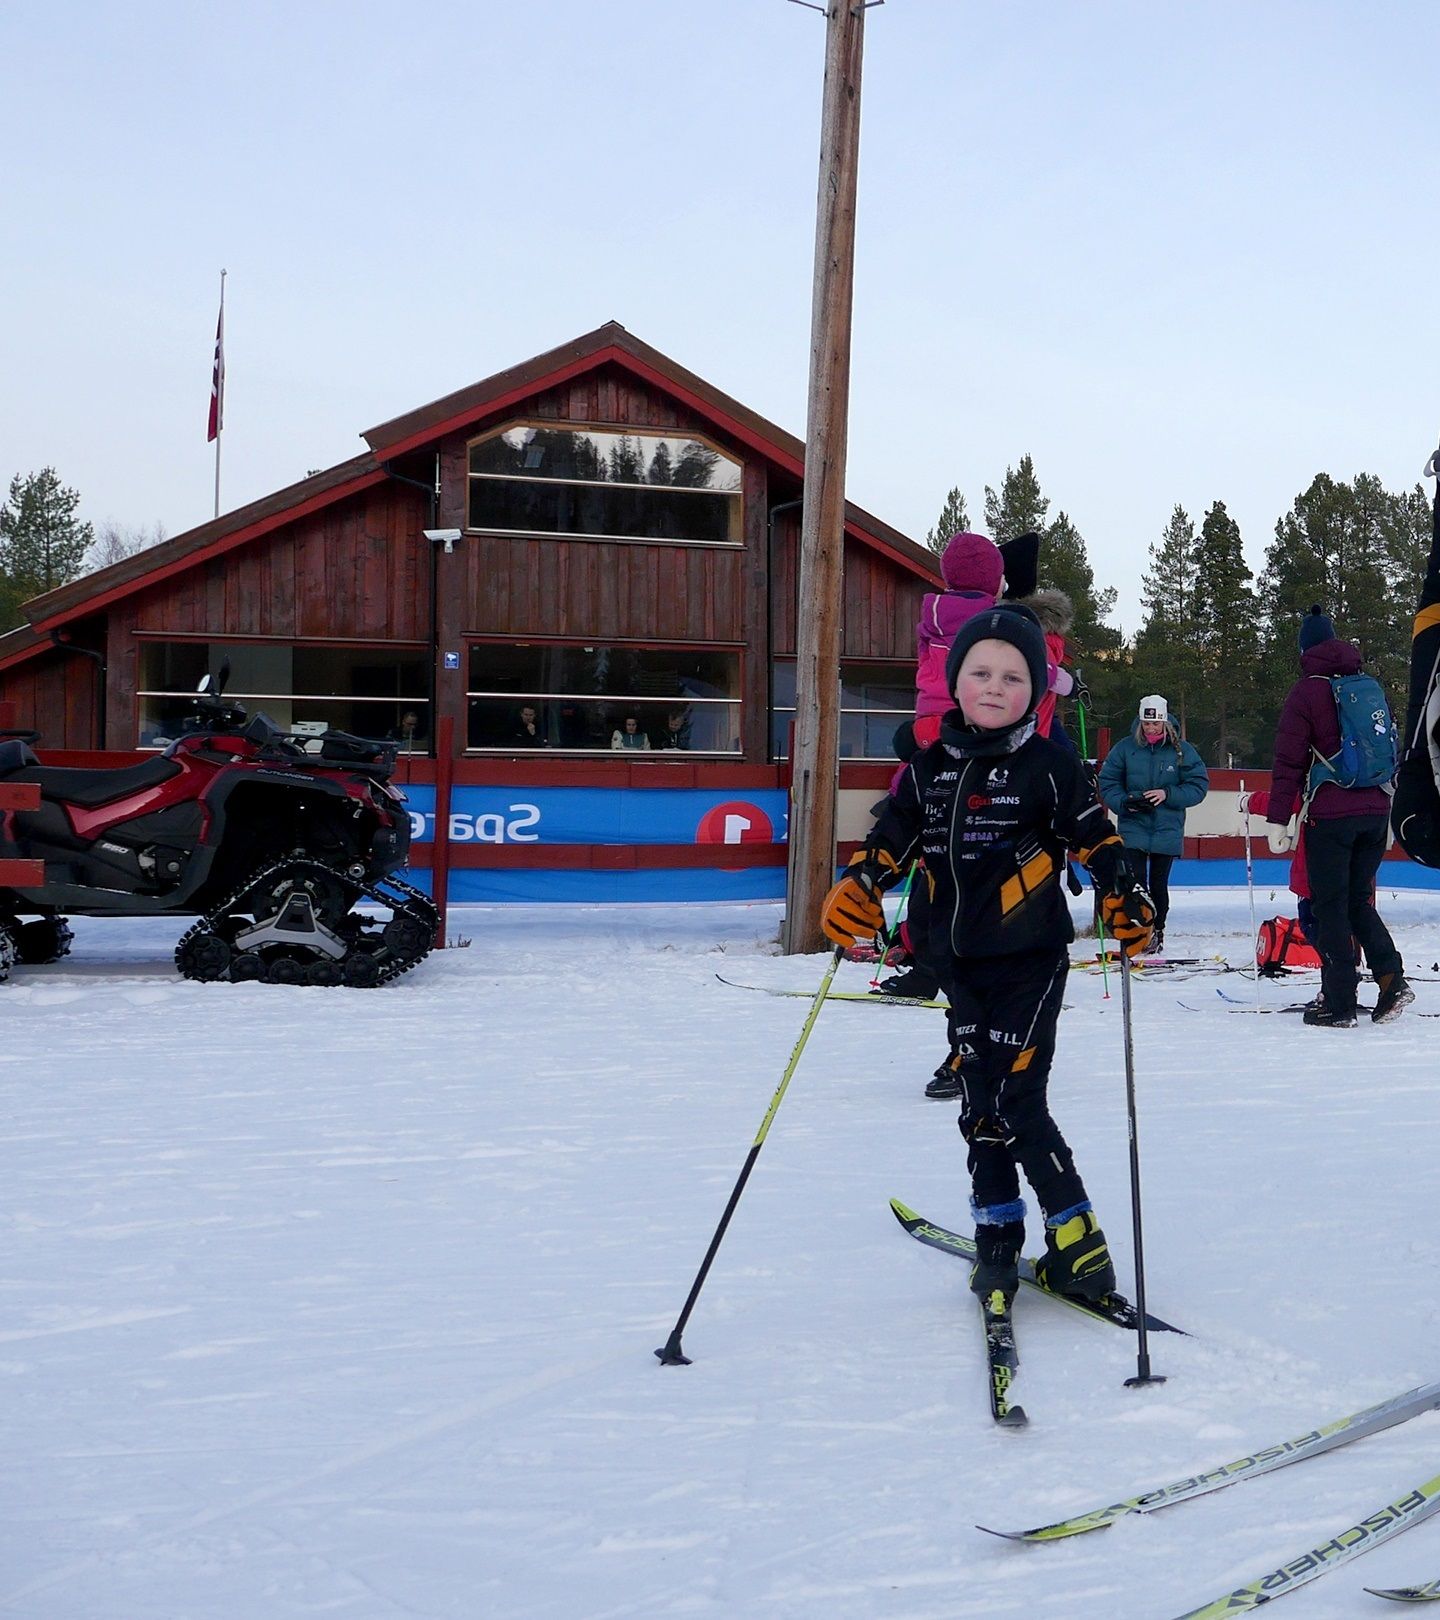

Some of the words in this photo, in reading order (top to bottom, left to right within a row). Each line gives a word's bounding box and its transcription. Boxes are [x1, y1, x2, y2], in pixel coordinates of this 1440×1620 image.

[256, 768, 315, 781] OUTLANDER
[1138, 1430, 1323, 1505] FISCHER
[1260, 1489, 1428, 1590] FISCHER
